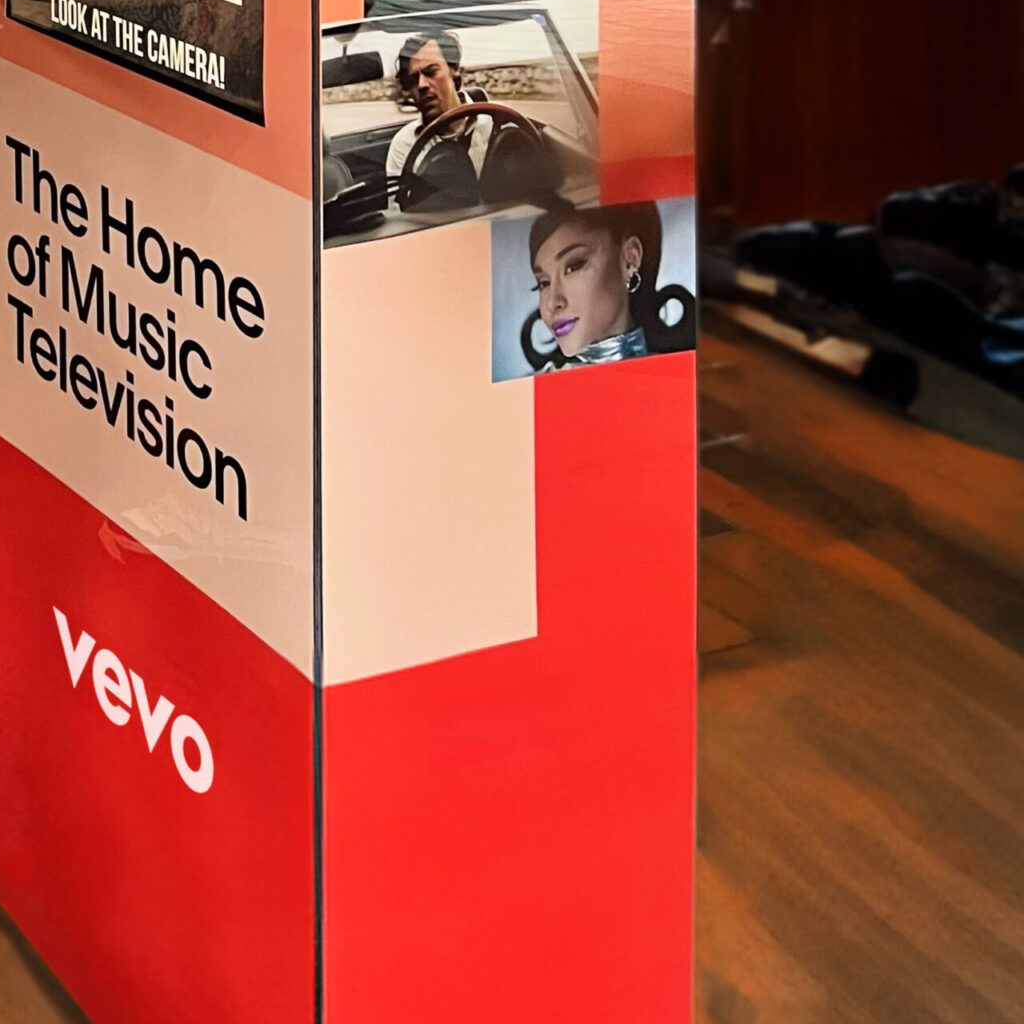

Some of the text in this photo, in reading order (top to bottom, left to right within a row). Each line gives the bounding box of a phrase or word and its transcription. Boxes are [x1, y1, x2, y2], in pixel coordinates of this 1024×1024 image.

[91, 8, 110, 43] AT
[113, 16, 144, 58] THE
[147, 29, 225, 89] CAMERA!
[5, 135, 265, 339] The Home
[7, 233, 213, 400] of Music
[7, 292, 248, 522] Television
[53, 605, 214, 794] vevo
